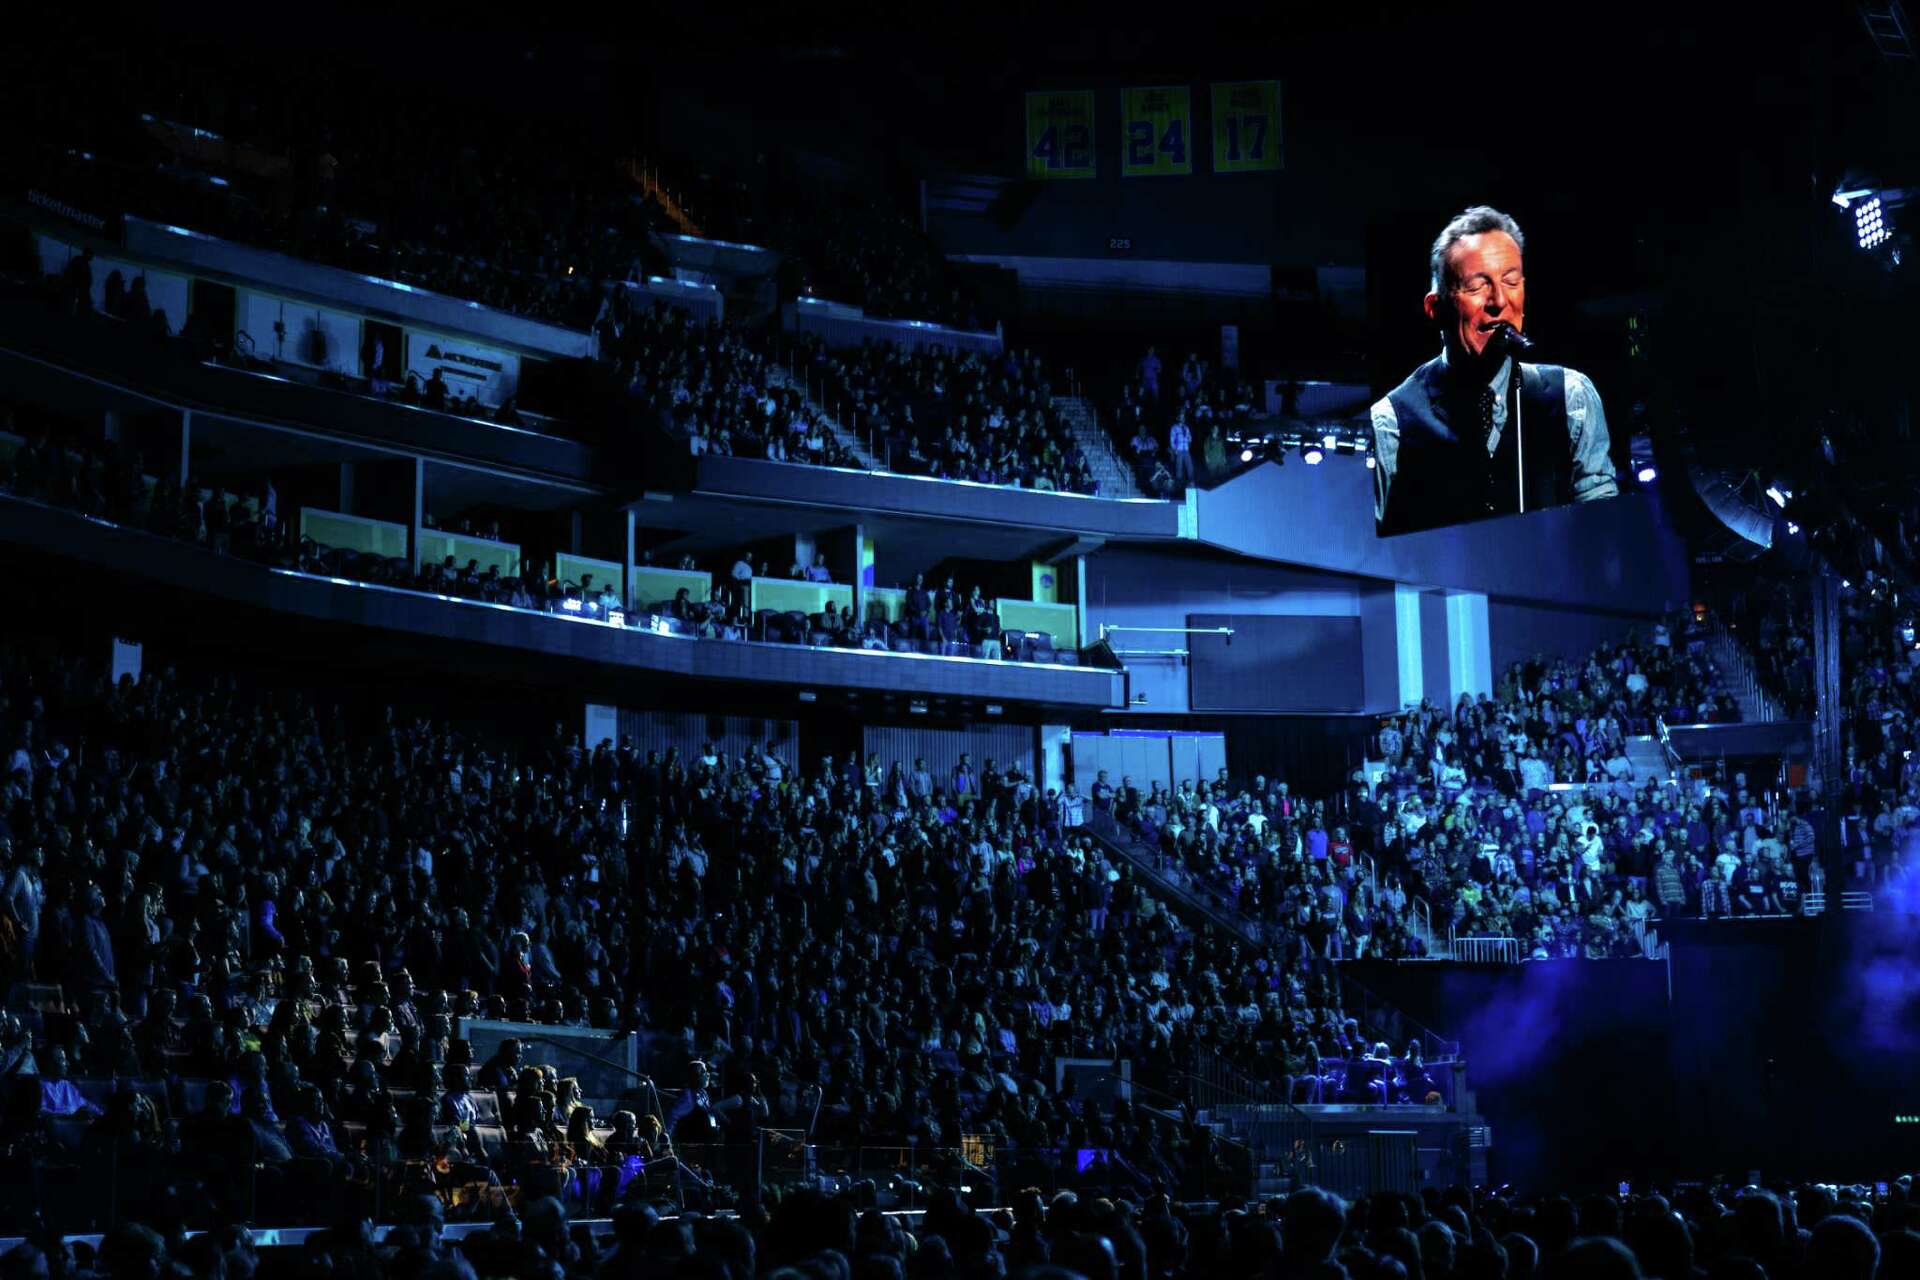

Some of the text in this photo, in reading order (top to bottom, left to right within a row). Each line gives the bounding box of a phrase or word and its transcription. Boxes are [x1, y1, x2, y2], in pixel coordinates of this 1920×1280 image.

[1034, 125, 1088, 169] 42
[1128, 119, 1185, 164] 24
[1225, 114, 1268, 160] 17
[1110, 239, 1131, 249] 225
